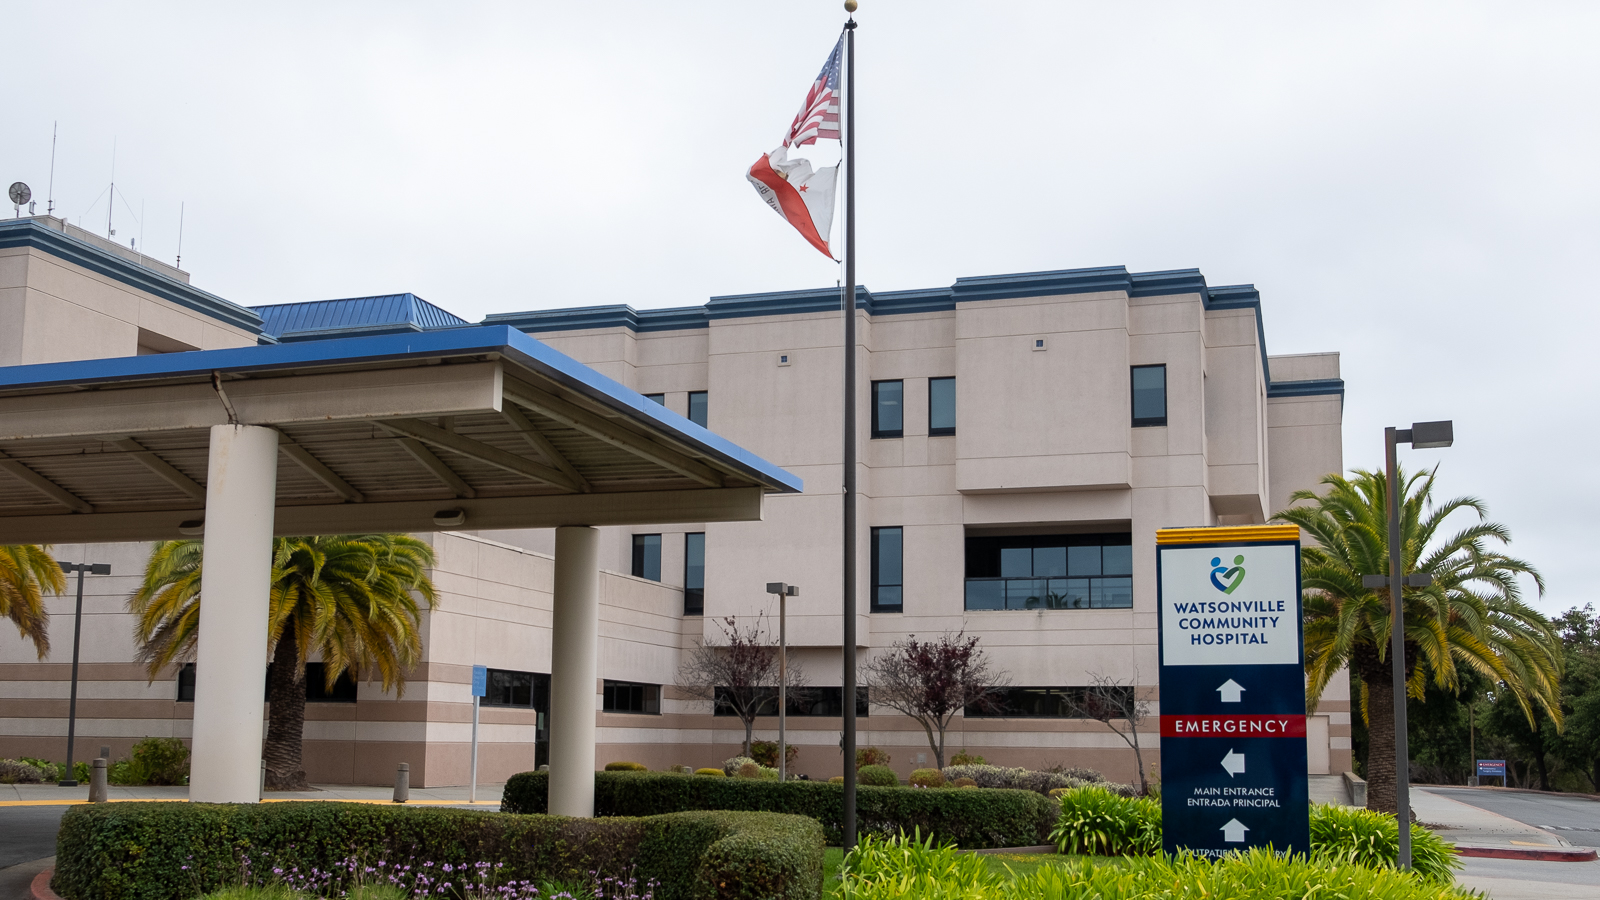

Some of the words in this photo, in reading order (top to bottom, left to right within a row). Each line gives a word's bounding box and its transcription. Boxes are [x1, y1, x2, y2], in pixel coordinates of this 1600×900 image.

[1173, 600, 1285, 614] WATSONVILLE
[1178, 616, 1280, 630] COMMUNITY
[1190, 632, 1268, 645] HOSPITAL
[1175, 719, 1289, 733] EMERGENCY
[1193, 787, 1221, 796] MAIN
[1223, 787, 1275, 797] ENTRANCE
[1187, 798, 1231, 807] ENTRADA
[1233, 798, 1281, 808] PRINCIPAL
